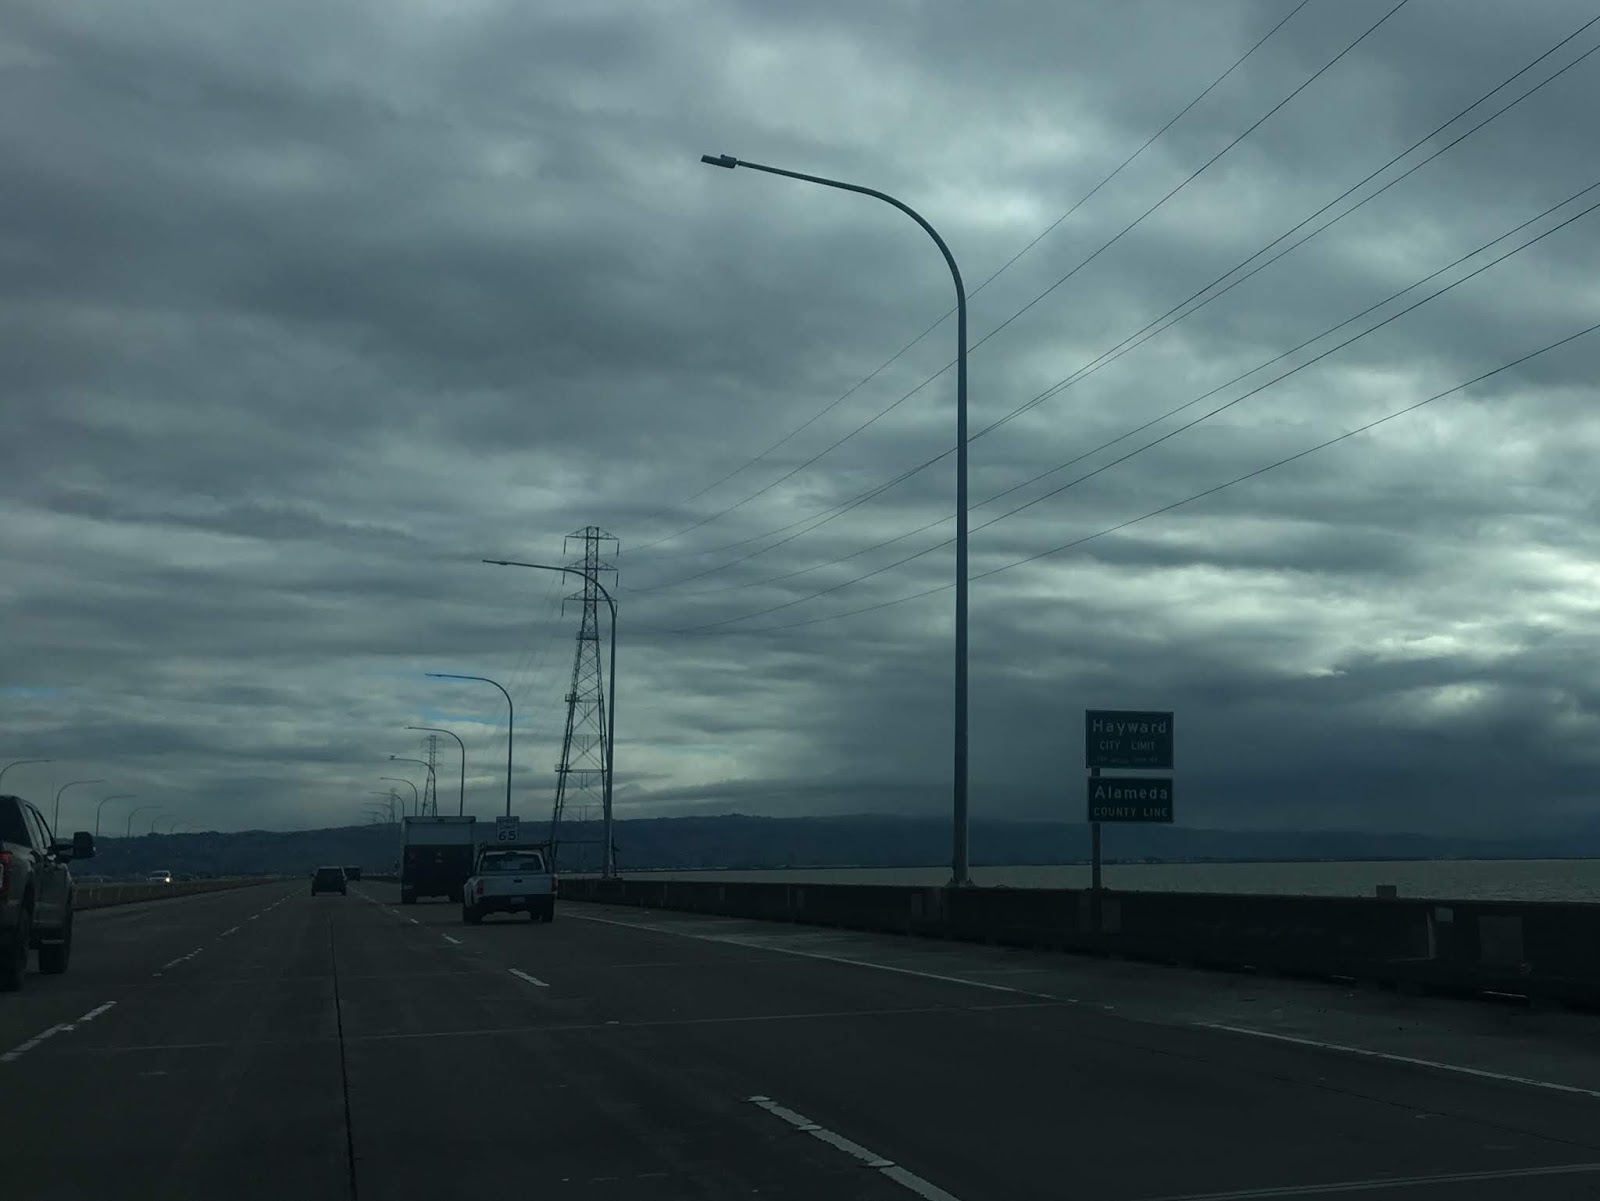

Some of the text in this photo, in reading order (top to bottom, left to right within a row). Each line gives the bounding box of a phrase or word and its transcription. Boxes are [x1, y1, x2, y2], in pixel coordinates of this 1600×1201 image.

[1092, 719, 1167, 736] Hayward
[1099, 740, 1156, 750] CITY LIMIT
[1094, 785, 1168, 800] Alameda
[1094, 807, 1168, 817] COUNTY LINE
[499, 831, 516, 841] 65
